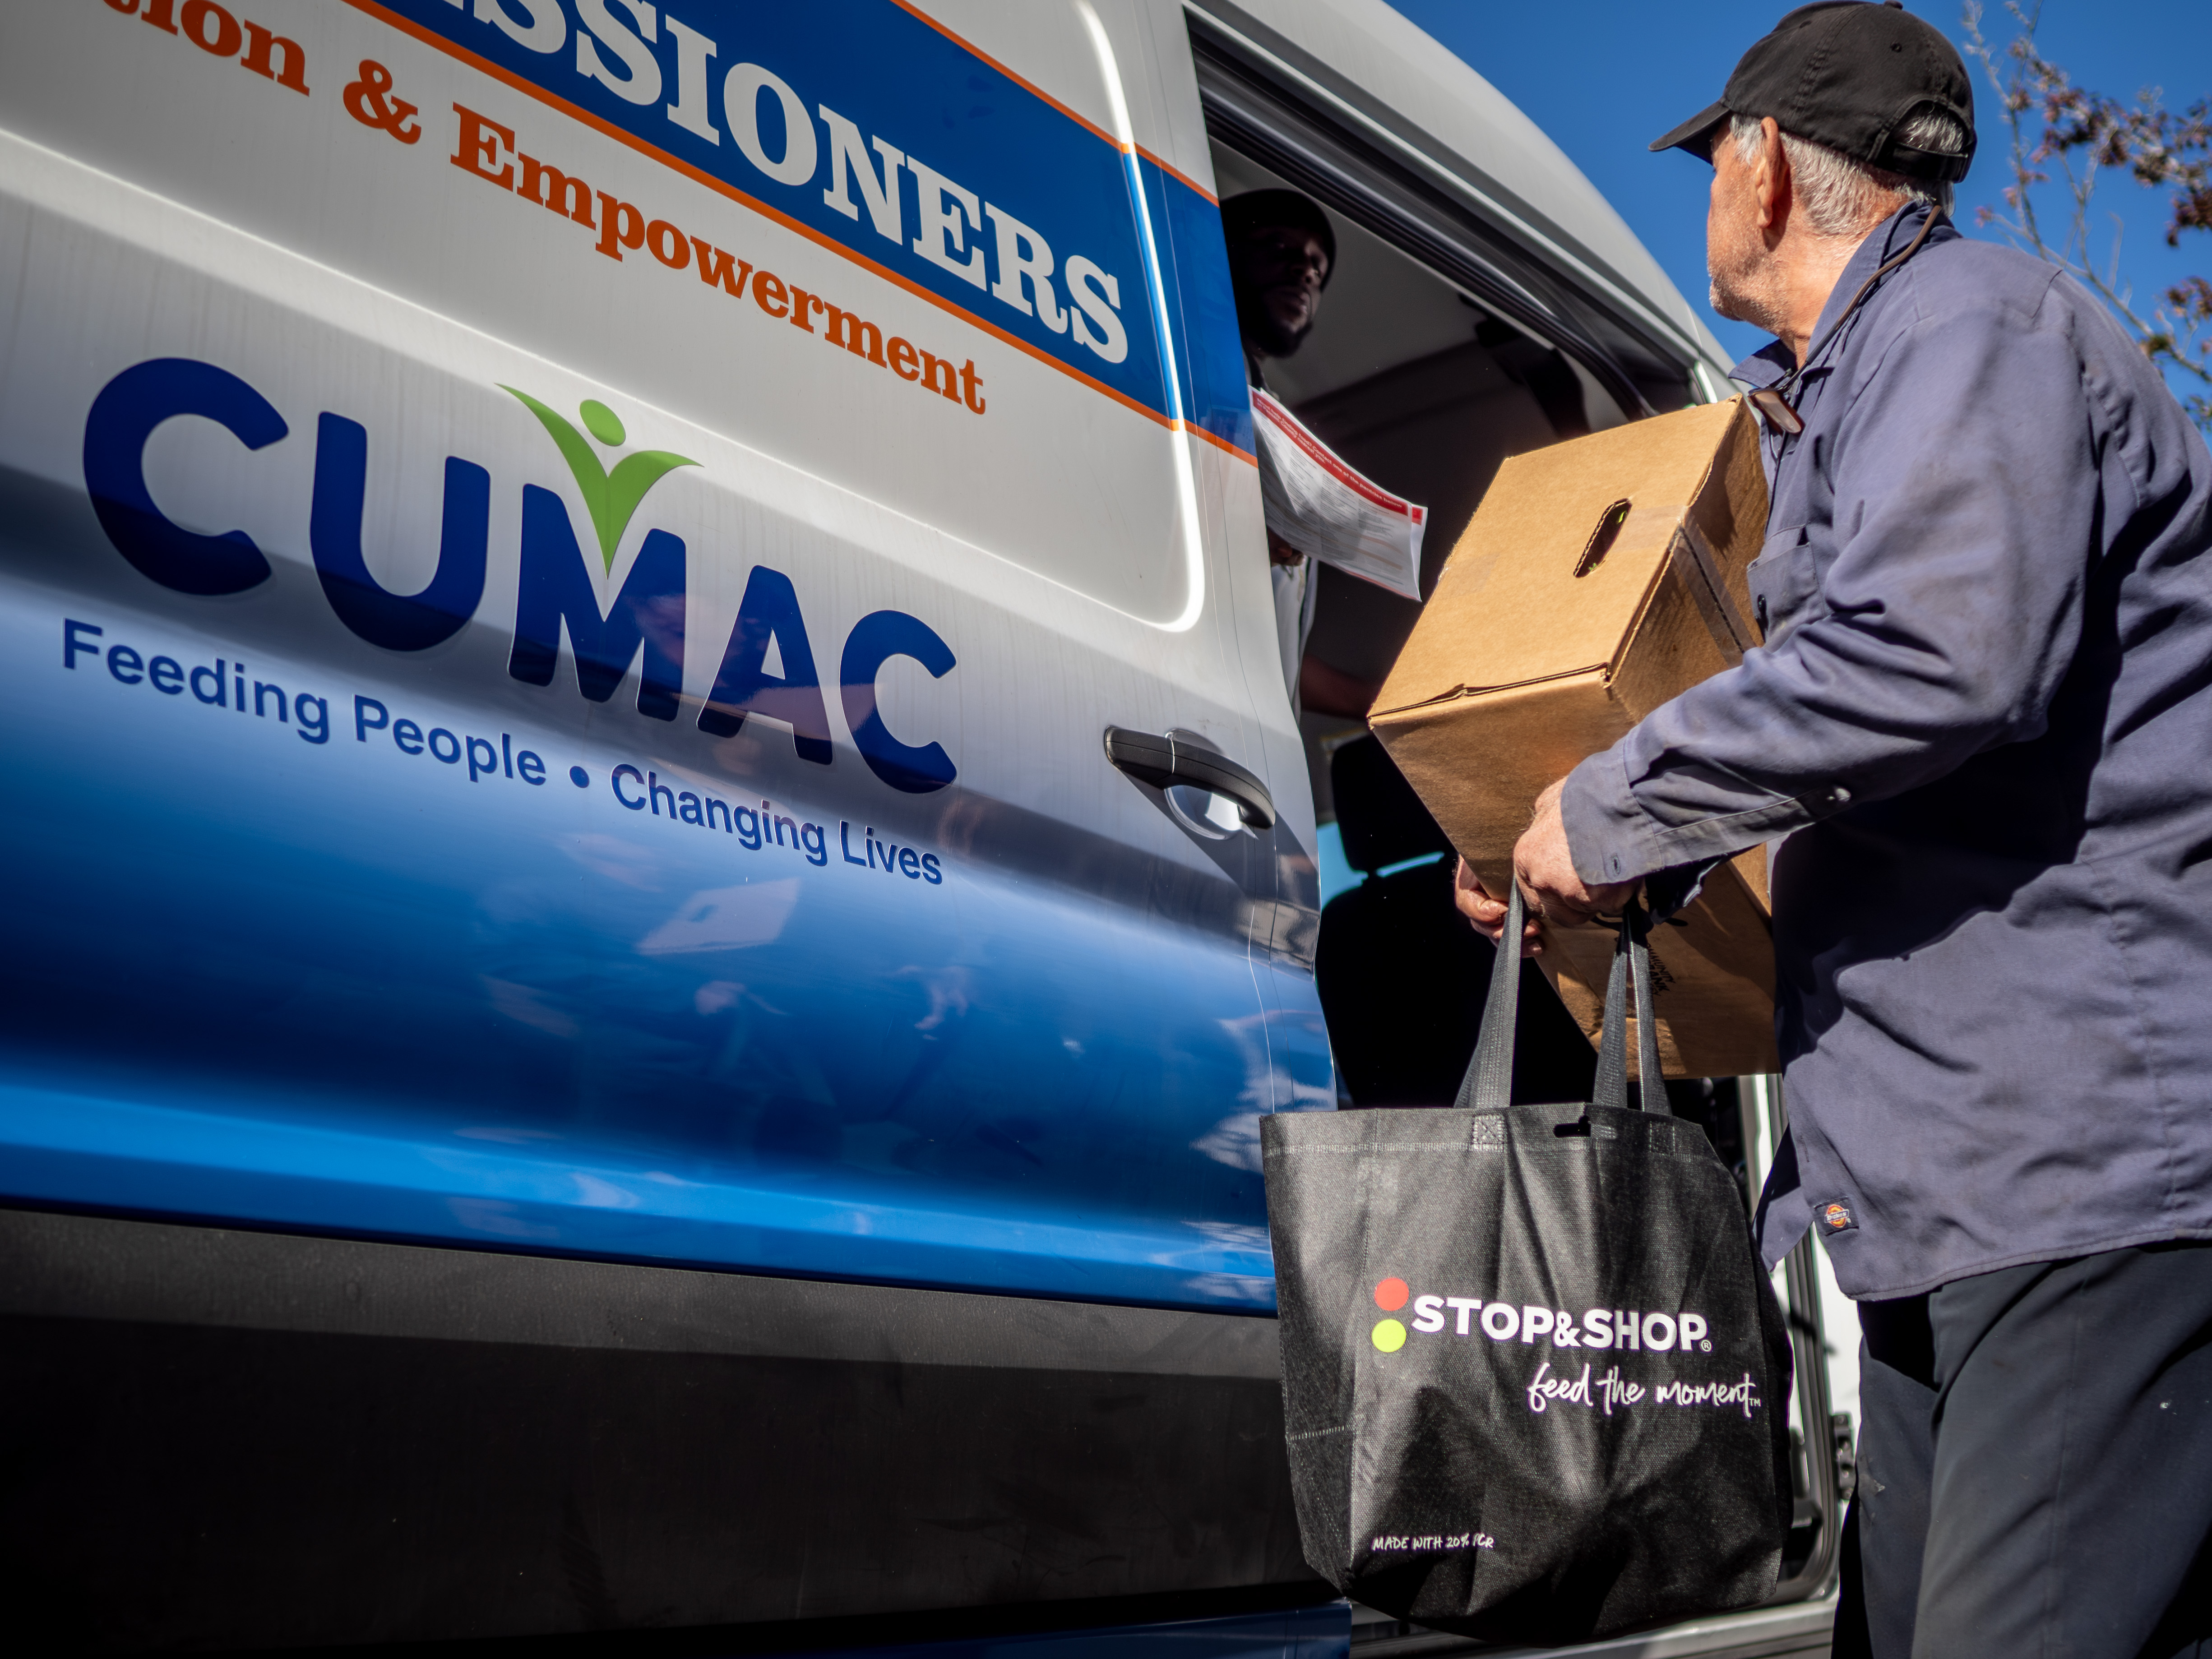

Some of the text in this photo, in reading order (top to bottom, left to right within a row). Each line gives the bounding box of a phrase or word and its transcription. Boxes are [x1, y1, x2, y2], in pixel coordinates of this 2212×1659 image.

[105, 0, 986, 415] ion & Empowerment
[444, 0, 1127, 363] SSIONERS
[83, 357, 957, 795] CUMAC
[1313, 445, 1333, 465] Contact
[1333, 463, 1343, 472] one
[1350, 476, 1360, 485] the
[1359, 482, 1383, 500] pantries
[1383, 497, 1403, 508] below
[63, 617, 943, 885] Feeding People Changing Lives
[1527, 1362, 1593, 1412] feed
[1596, 1366, 1646, 1415] the
[1372, 1536, 1409, 1551] MADE
[1413, 1535, 1443, 1550] WITH
[1445, 1532, 1470, 1548] 20%
